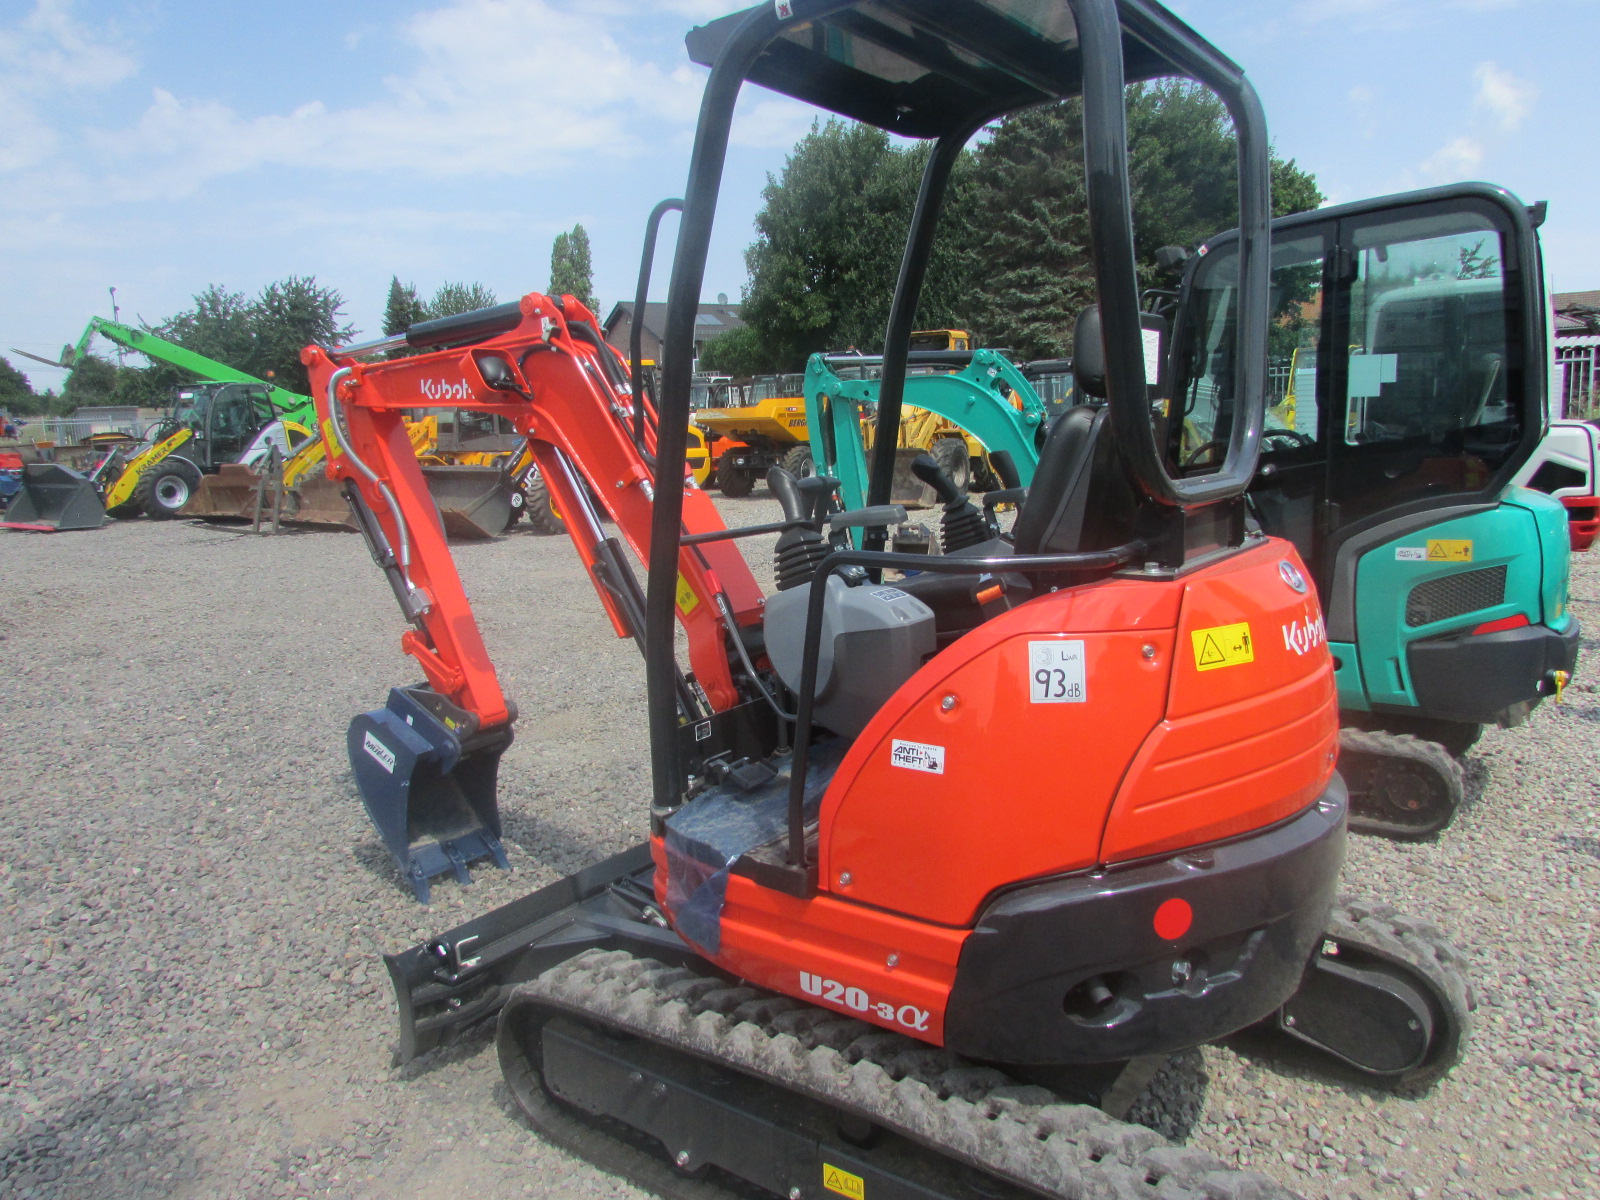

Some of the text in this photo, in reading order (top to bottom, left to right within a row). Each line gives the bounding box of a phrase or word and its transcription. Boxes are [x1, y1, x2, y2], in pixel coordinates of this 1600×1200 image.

[135, 447, 169, 476] KRAMER
[893, 745, 919, 756] ANTI
[892, 753, 924, 765] THEFT
